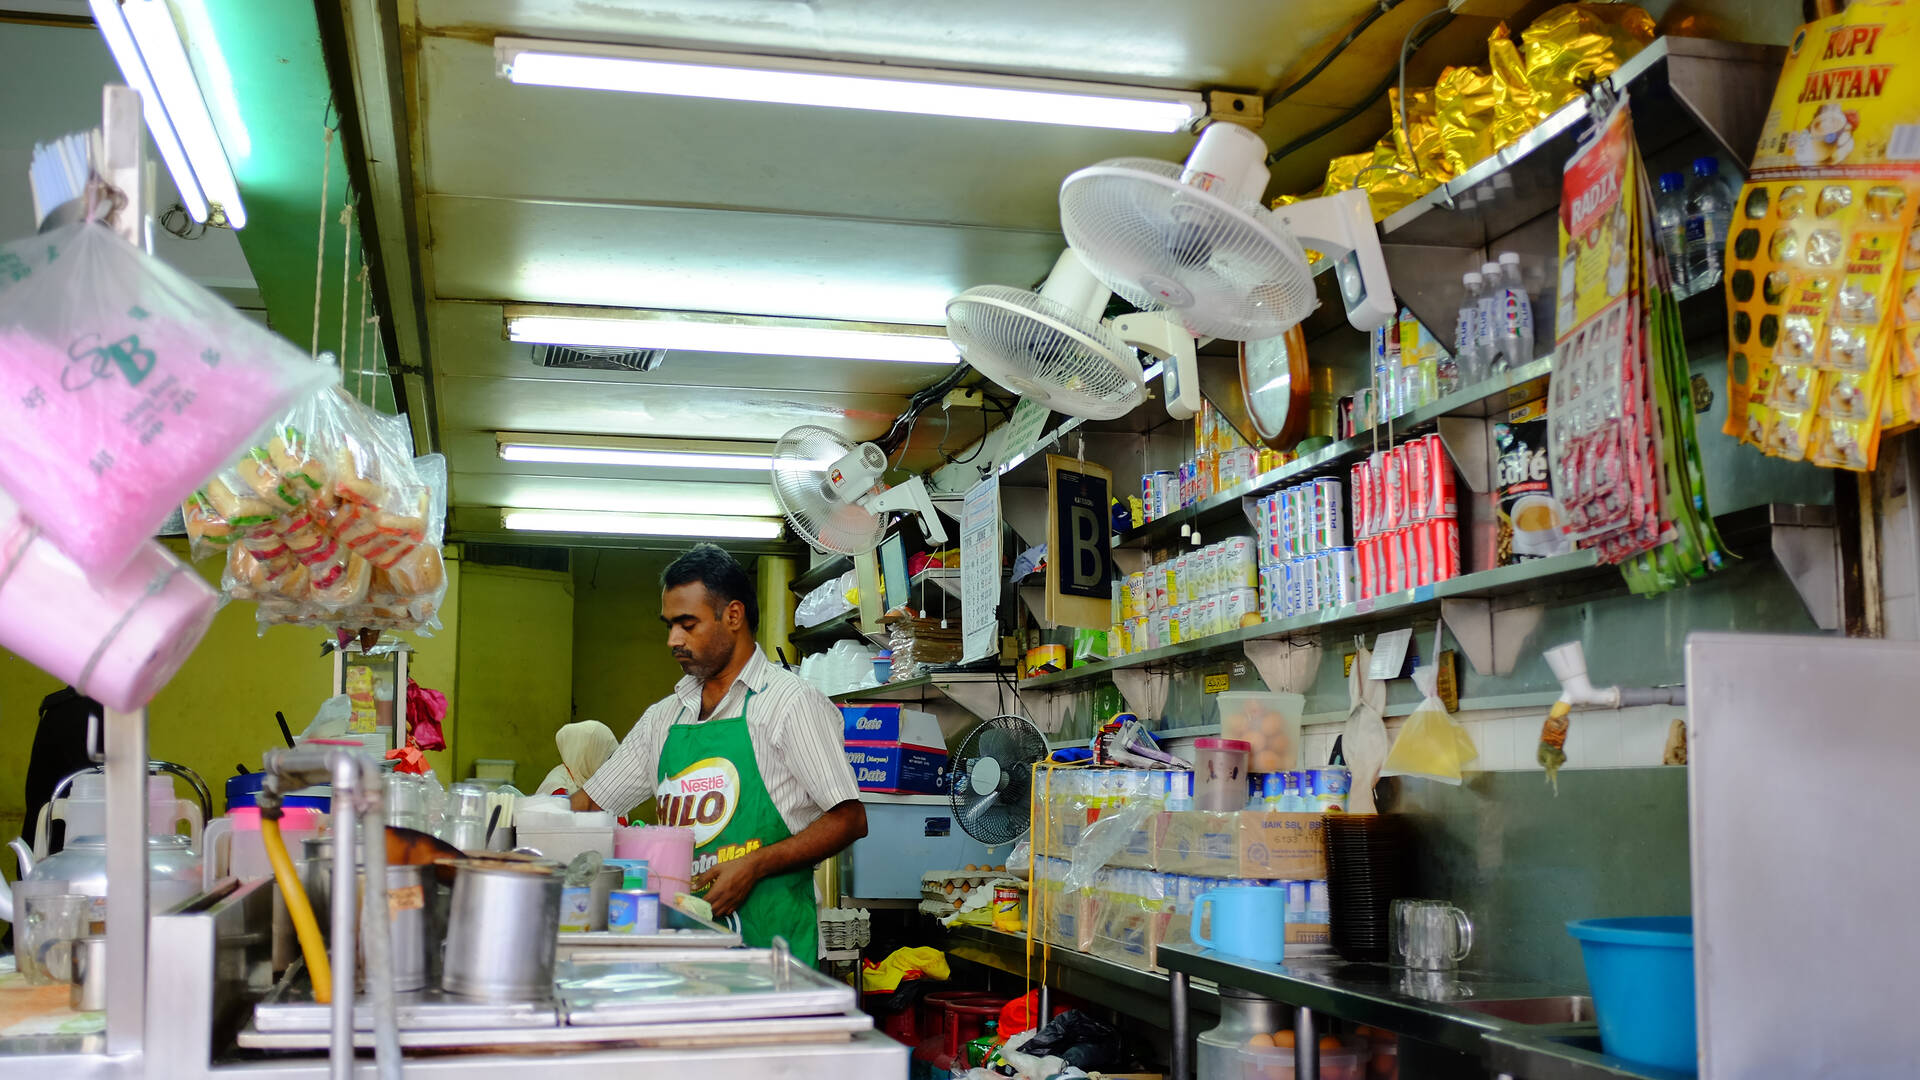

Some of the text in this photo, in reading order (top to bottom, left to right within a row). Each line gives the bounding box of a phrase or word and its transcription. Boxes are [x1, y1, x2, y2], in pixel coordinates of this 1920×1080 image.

[1822, 26, 1883, 61] KOPI
[1798, 67, 1892, 104] JANTAN
[1571, 166, 1617, 227] RADIX
[1497, 447, 1548, 487] café
[1071, 505, 1103, 588] B
[856, 716, 882, 730] Date
[681, 775, 726, 793] Nestlé
[858, 767, 887, 782] Date
